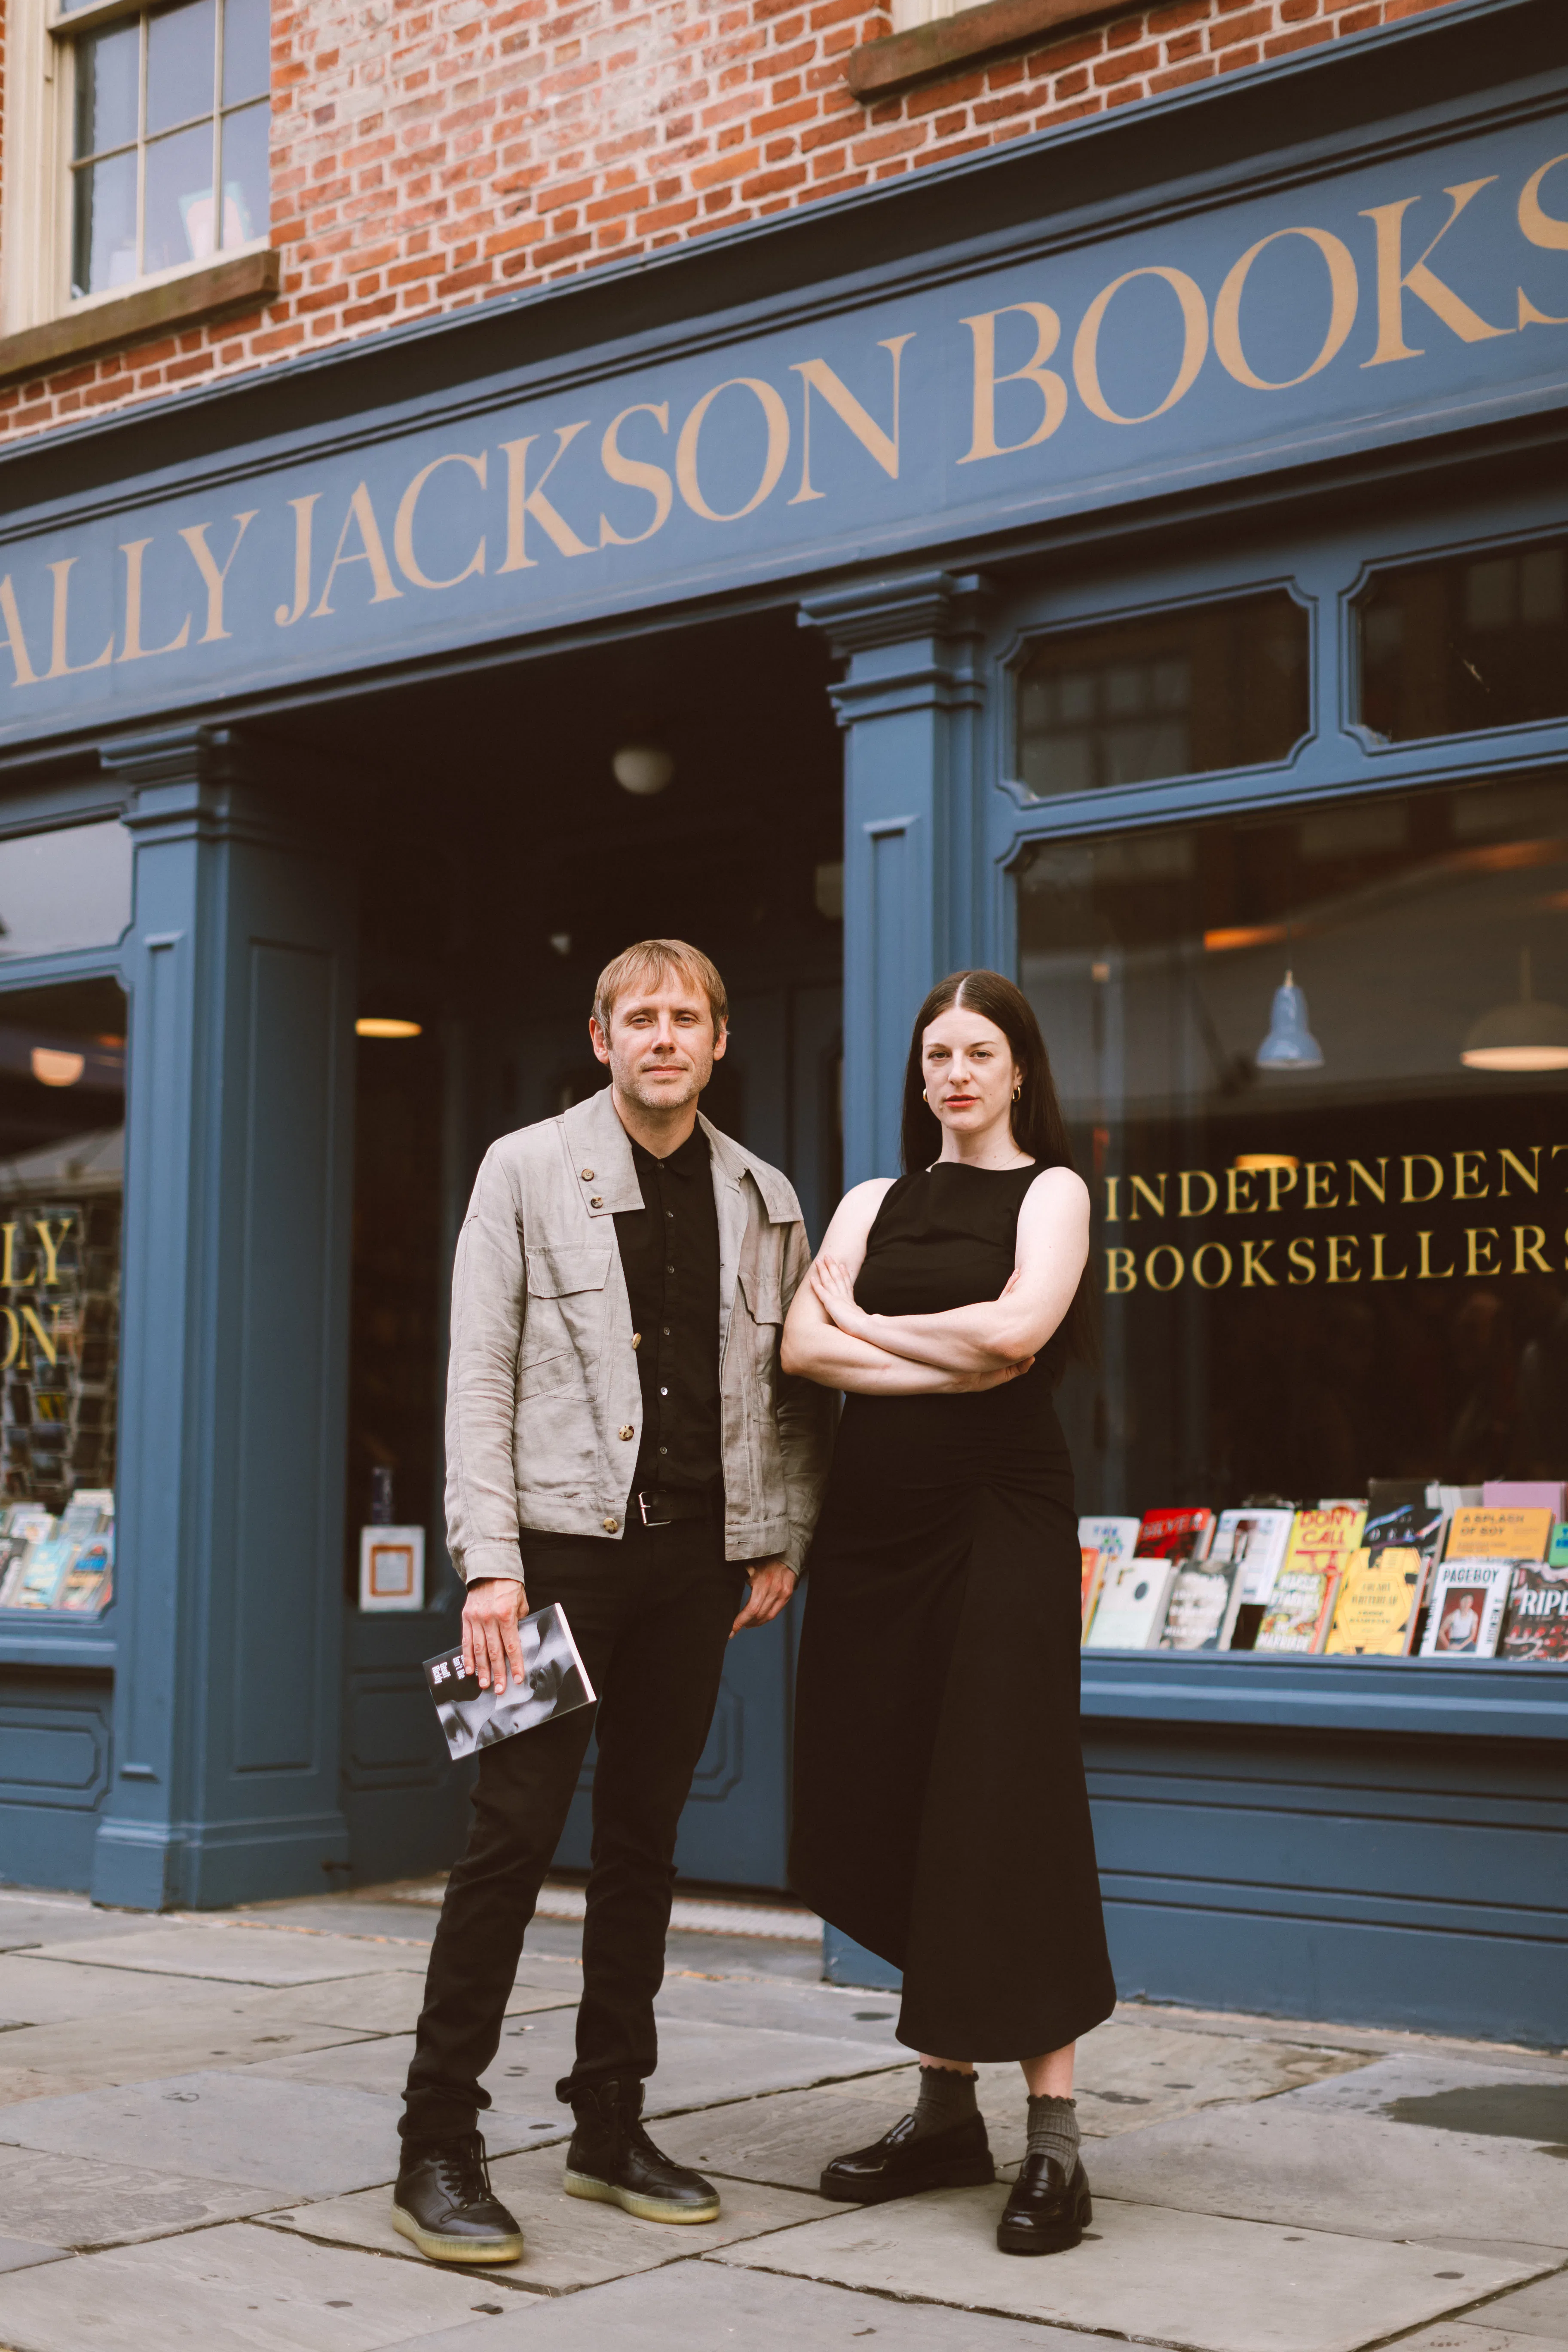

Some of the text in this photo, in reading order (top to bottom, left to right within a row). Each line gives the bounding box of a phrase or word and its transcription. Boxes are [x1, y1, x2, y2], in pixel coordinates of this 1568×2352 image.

[273, 331, 917, 628] JACKSON
[956, 152, 1568, 465] BOOKS
[1105, 1225, 1568, 1293] BOOKSELLER
[1142, 1513, 1204, 1538] SILVER
[1302, 1529, 1344, 1545] CALL
[1442, 1568, 1500, 1584] PAGEBOY
[439, 1662, 451, 1678] Geoff
[453, 1656, 463, 1671] Isn't
[432, 1665, 443, 1684] Rickly
[457, 1669, 466, 1680] Me
